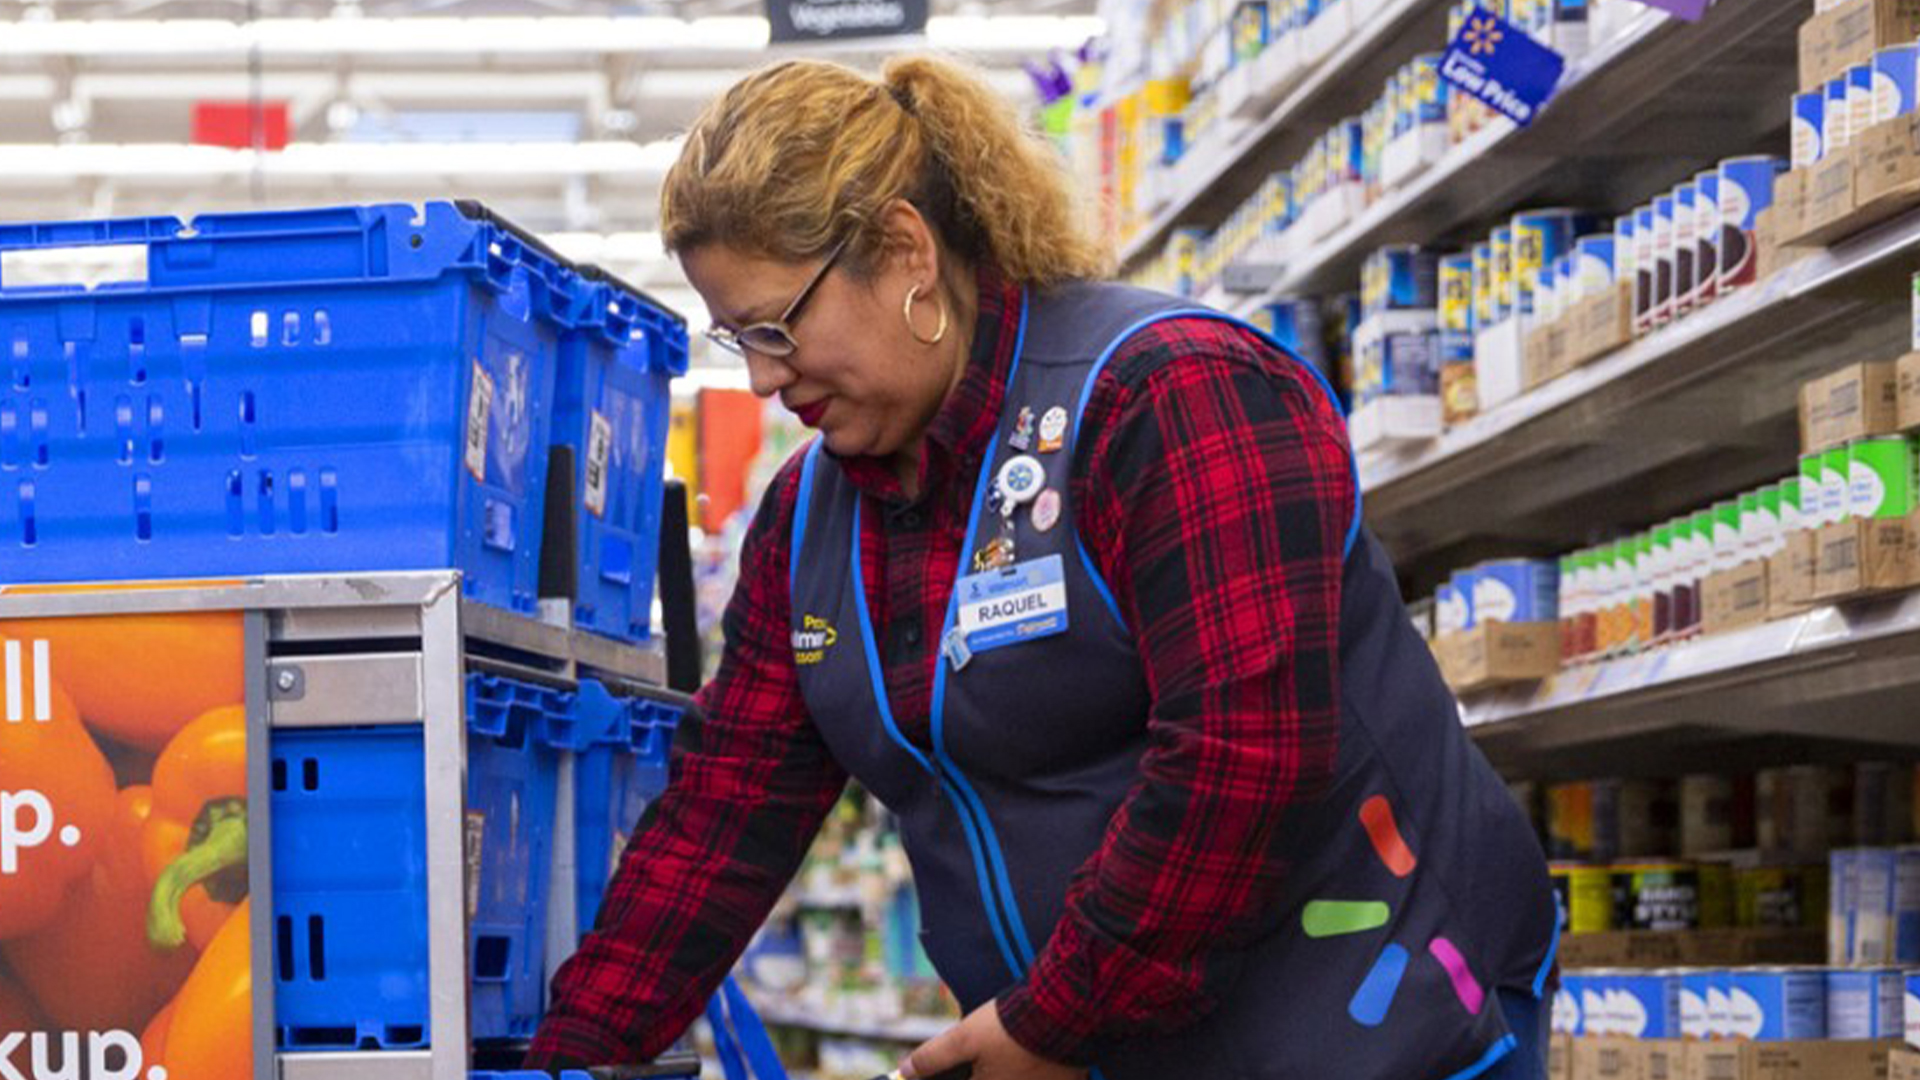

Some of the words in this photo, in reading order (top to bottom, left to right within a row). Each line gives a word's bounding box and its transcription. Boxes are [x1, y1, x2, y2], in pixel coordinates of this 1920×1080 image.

[1442, 49, 1485, 93] Low
[1481, 79, 1531, 121] Price
[978, 593, 1047, 622] RAQUEL
